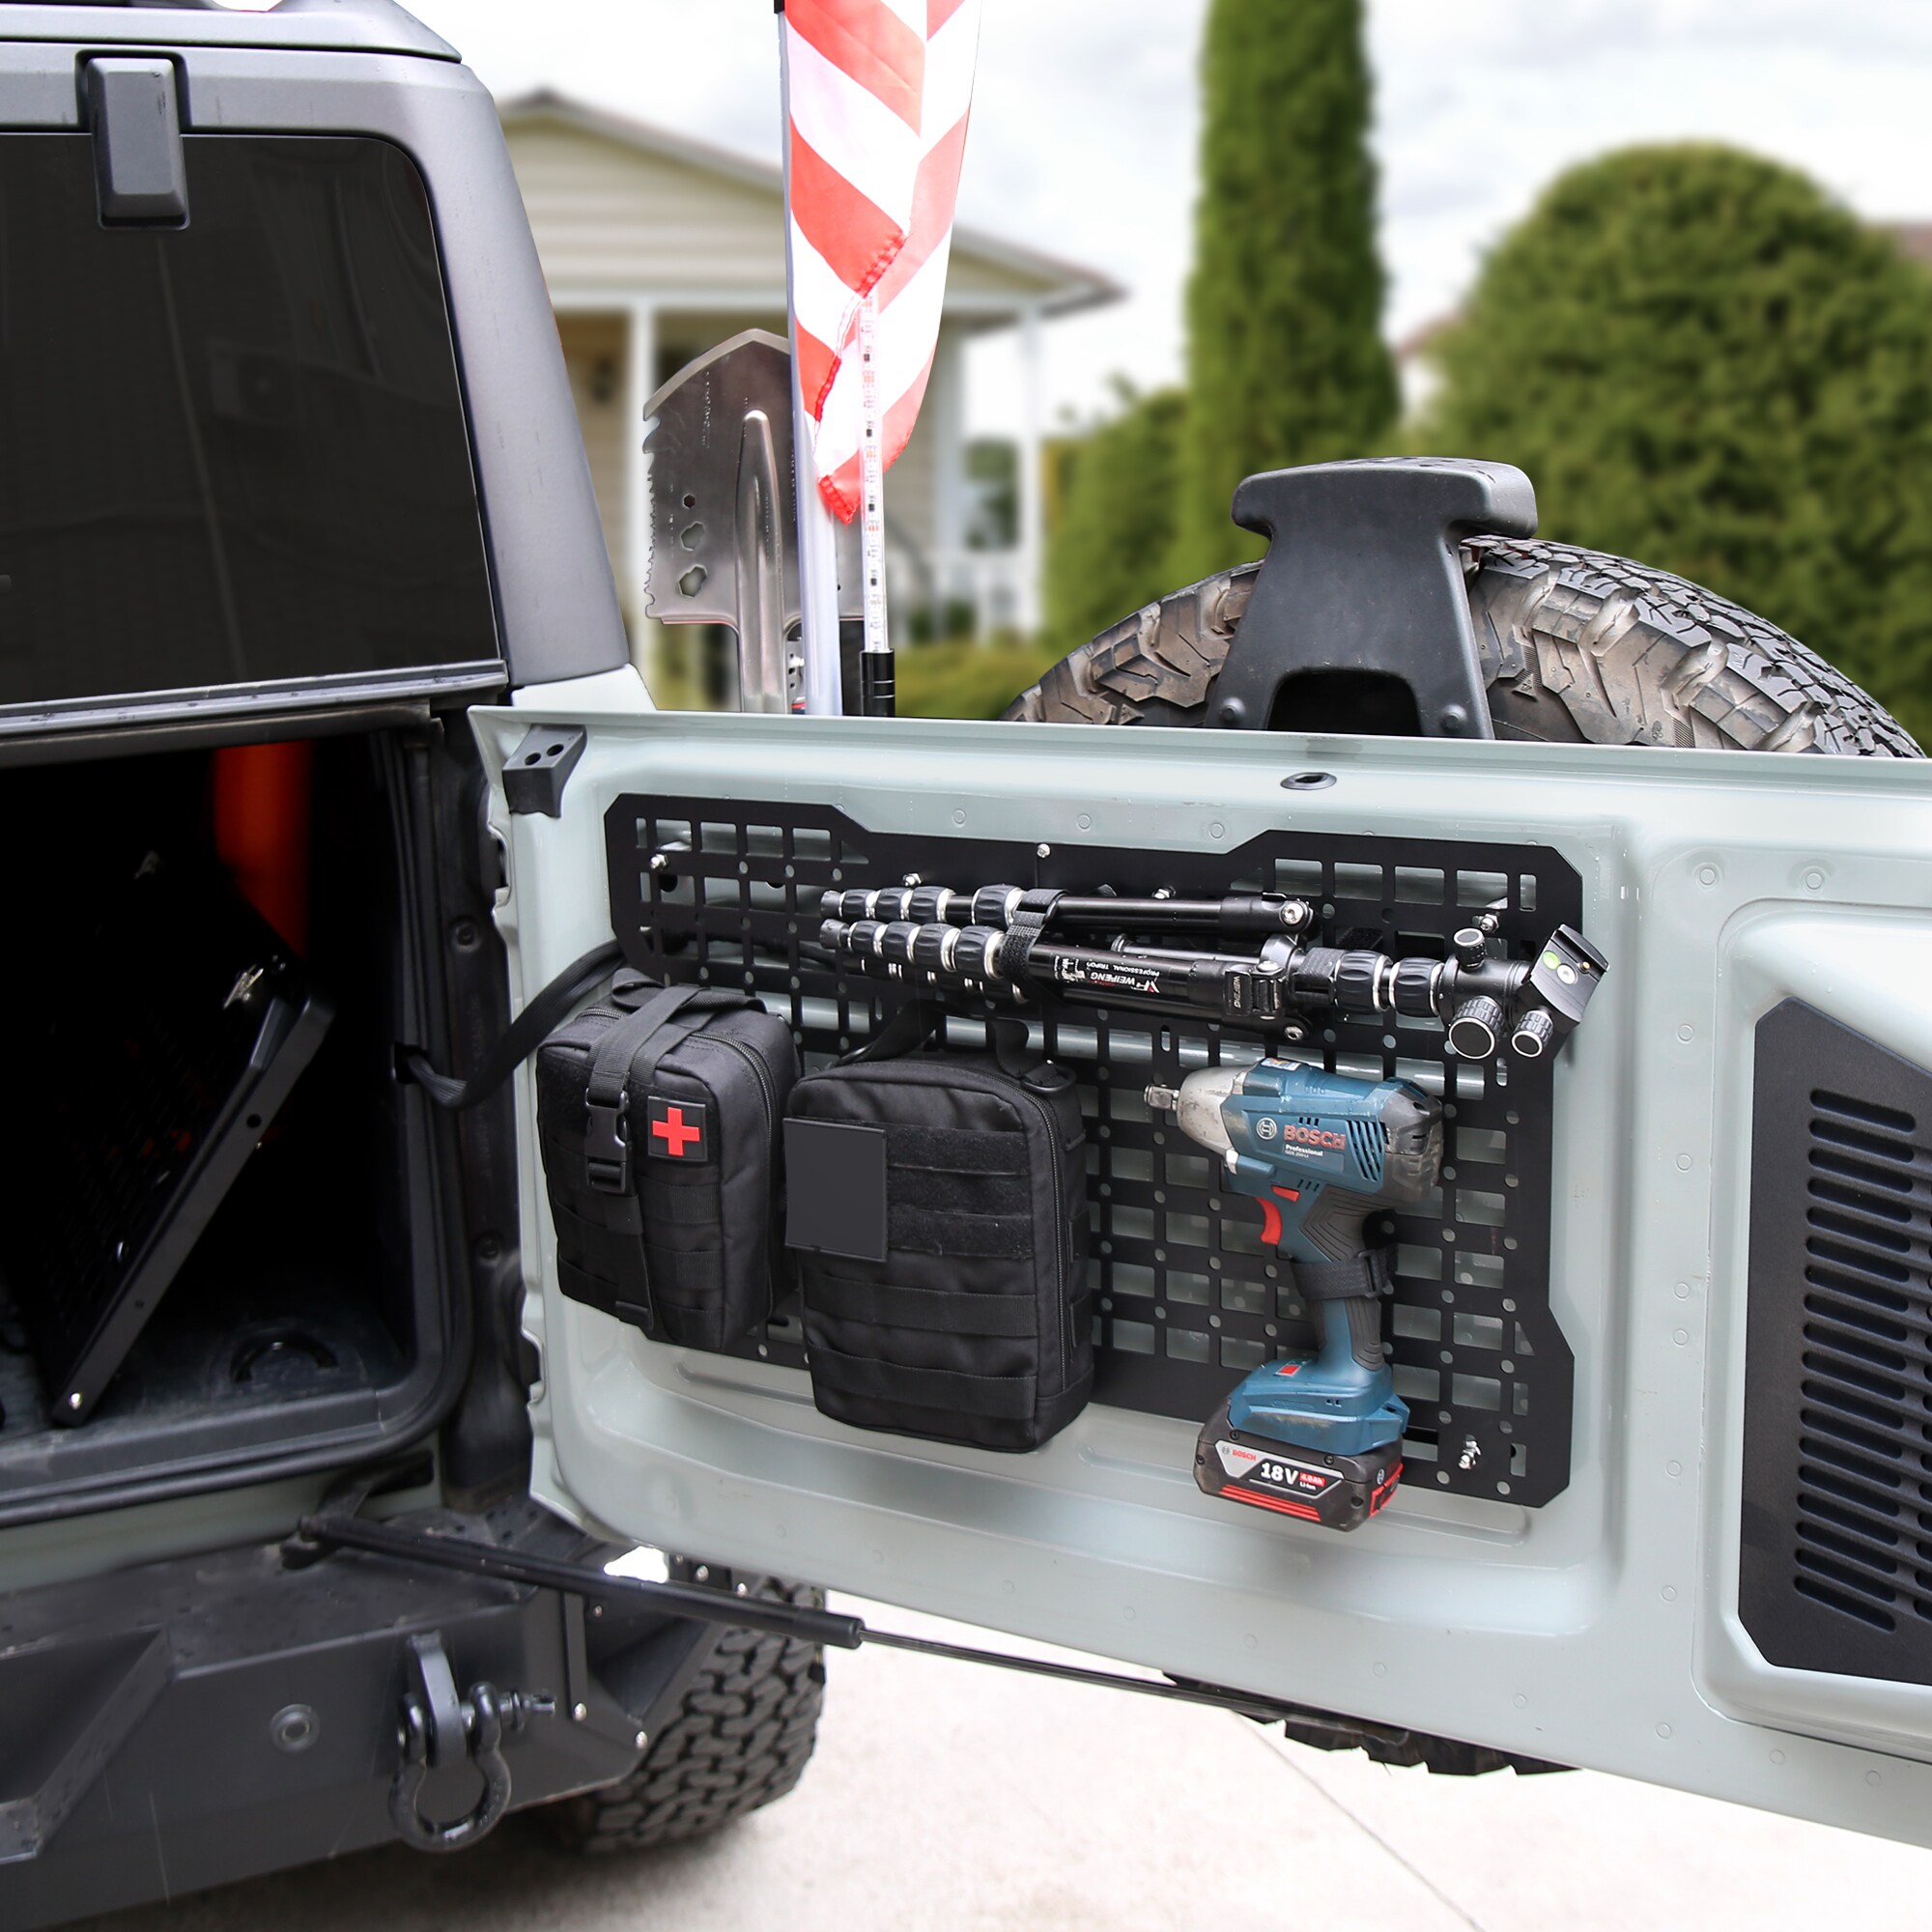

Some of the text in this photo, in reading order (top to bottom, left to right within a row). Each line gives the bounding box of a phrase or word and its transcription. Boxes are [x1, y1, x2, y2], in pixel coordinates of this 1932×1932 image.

[1113, 965, 1160, 977] PROFESSIONAL
[1284, 1124, 1346, 1150] BOSCH
[1285, 1144, 1323, 1156] Professional
[1232, 1449, 1257, 1462] BOSCH
[1261, 1462, 1299, 1485] 18V
